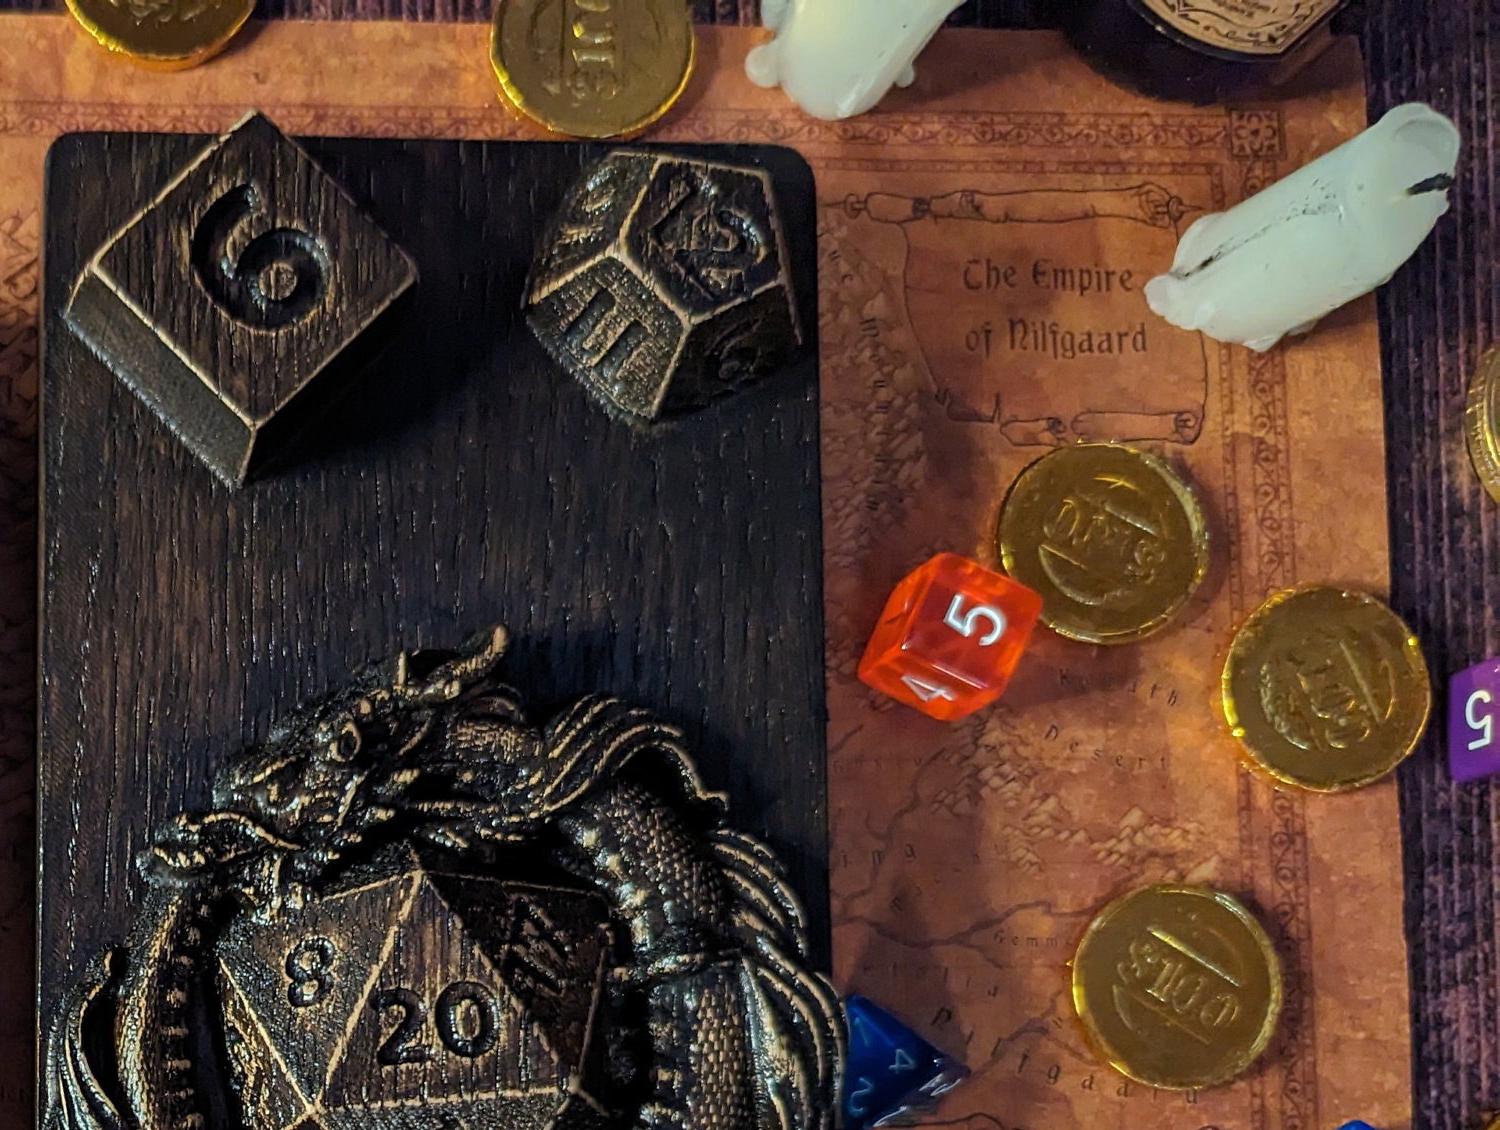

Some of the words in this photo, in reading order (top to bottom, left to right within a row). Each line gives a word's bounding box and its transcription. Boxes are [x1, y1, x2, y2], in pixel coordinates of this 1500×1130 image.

[190, 182, 333, 334] 6
[963, 258, 1017, 291] The
[1031, 258, 1134, 297] Empire
[964, 322, 992, 359] of
[1007, 317, 1147, 360] Nilfgaard
[943, 594, 1009, 648] 5
[901, 674, 955, 703] 4
[1465, 689, 1492, 751] 5
[370, 979, 502, 1067] 20
[887, 1047, 917, 1075] 4
